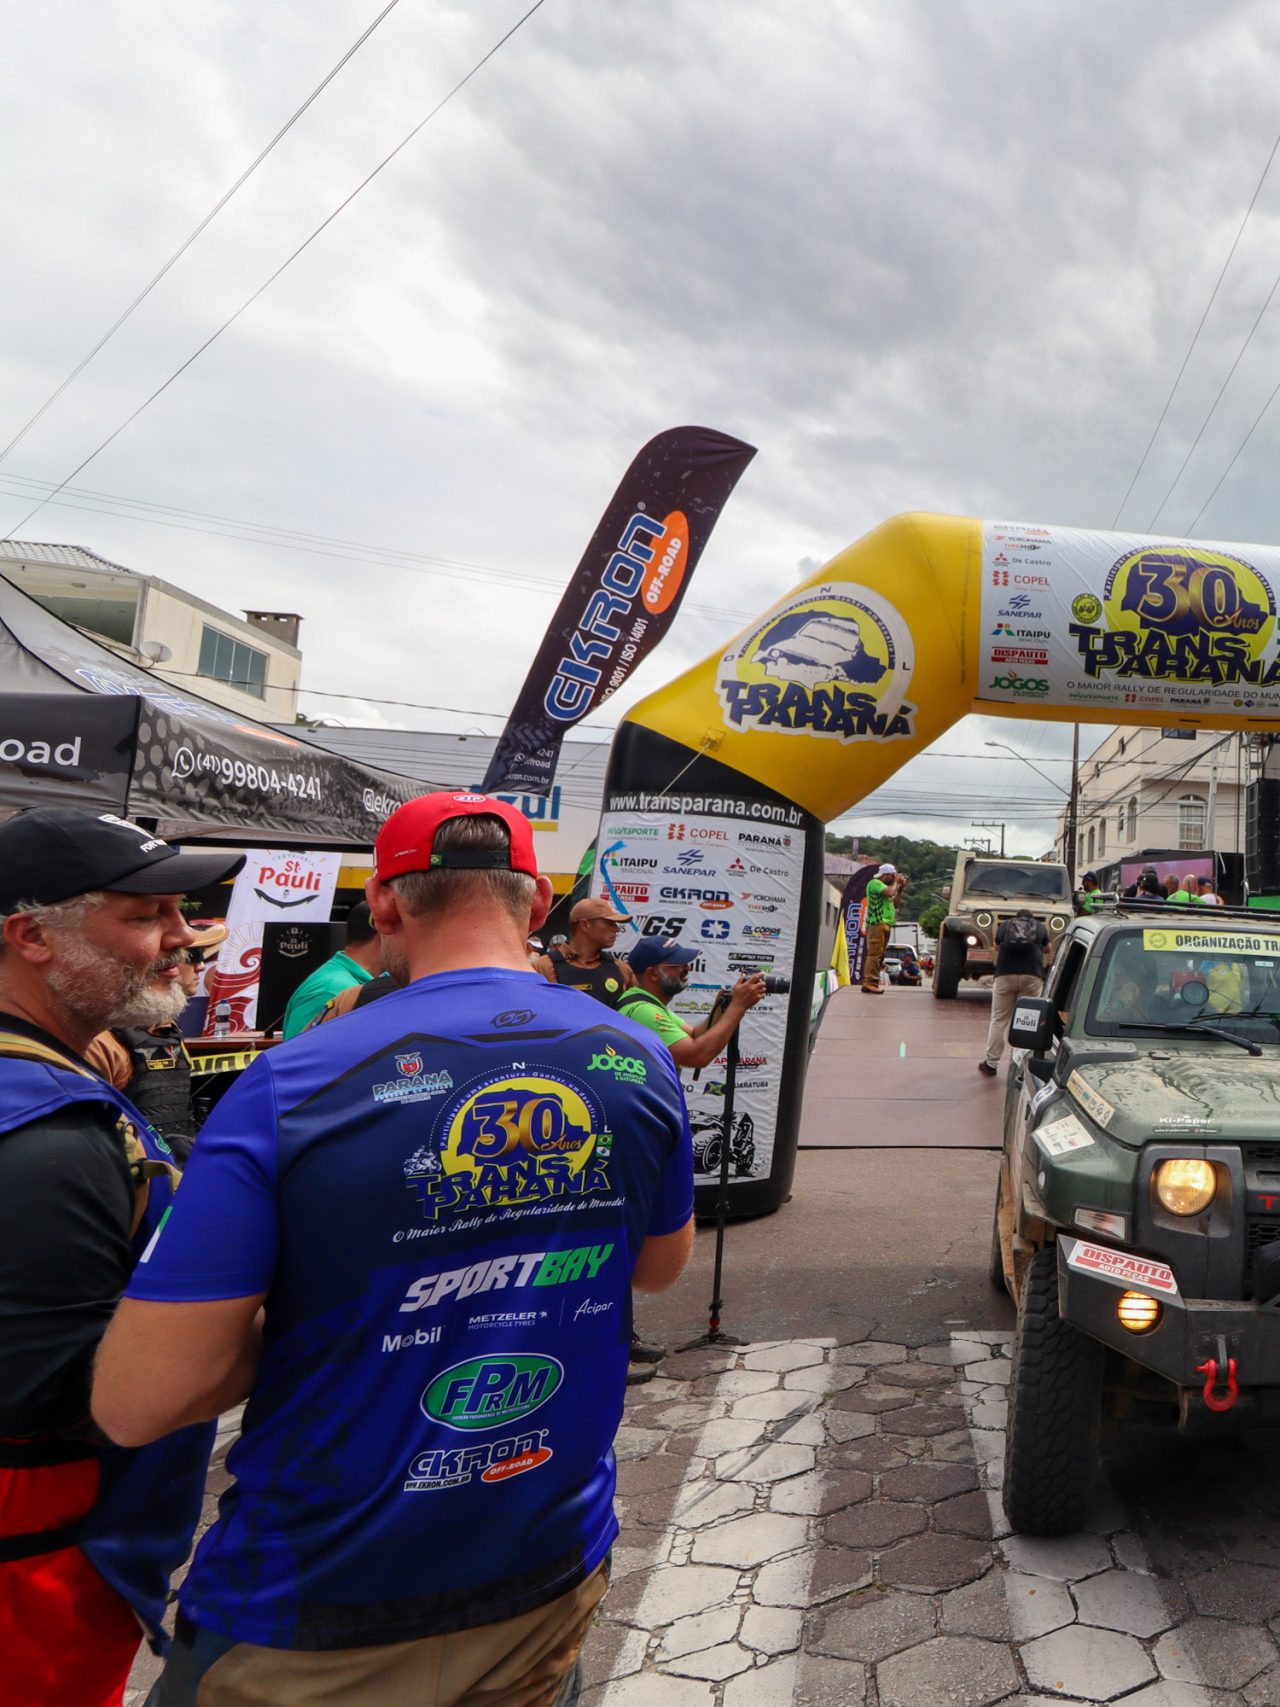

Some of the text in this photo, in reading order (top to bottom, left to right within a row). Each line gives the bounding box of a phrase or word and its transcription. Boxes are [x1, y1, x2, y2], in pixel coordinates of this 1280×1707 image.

[646, 538, 681, 604] OFF-ROAD
[1014, 575, 1050, 585] COPEL
[1137, 561, 1240, 629] 30
[998, 609, 1042, 619] SANEPAR
[1017, 630, 1050, 638] ITAIPU
[1069, 623, 1251, 661] TRANS
[610, 666, 627, 690] 9001
[621, 643, 637, 661] ISO
[630, 618, 648, 646] 14001
[994, 650, 1046, 658] DISPAUTO
[989, 676, 1050, 691] JOGOS
[1067, 681, 1075, 689] O
[1078, 682, 1111, 691] MAIOR
[1114, 684, 1145, 693] RALLY
[1164, 688, 1240, 698] REGULARIDADE
[1244, 691, 1257, 699] DO
[721, 679, 877, 715] TRANS
[730, 700, 913, 738] PARANÁ
[609, 792, 803, 826] www.transparana.com.br
[690, 828, 729, 841] COPEL
[620, 857, 658, 868] ITAIPU
[258, 867, 322, 891] Pauli
[662, 866, 716, 878] SANEPAR
[750, 865, 761, 874] De
[763, 866, 789, 877] Castro
[660, 887, 729, 901] EKRON
[1175, 935, 1261, 951] ORGANIZAÇÃO
[1016, 1018, 1036, 1027] Pauli
[512, 1062, 525, 1070] N
[587, 1054, 646, 1076] JOGOS
[373, 1070, 451, 1096] PARANÁ
[472, 1098, 565, 1158] 30
[604, 1125, 612, 1133] L
[541, 1134, 582, 1150] Anos
[406, 1154, 574, 1196] TRANS
[416, 1159, 612, 1221] PARANÁ
[392, 1197, 625, 1243] O Maior Rally de Regularidade do Mundo!
[1083, 1248, 1171, 1281] DISPAUTO
[1098, 1264, 1121, 1275] AUTO
[399, 1244, 615, 1312] SPORTBAY
[468, 1311, 537, 1324] METZELER
[468, 1320, 536, 1330] MOTORCYCLE TYRES
[382, 1326, 442, 1352] Mobil
[490, 1459, 533, 1475] OFF-ROAD
